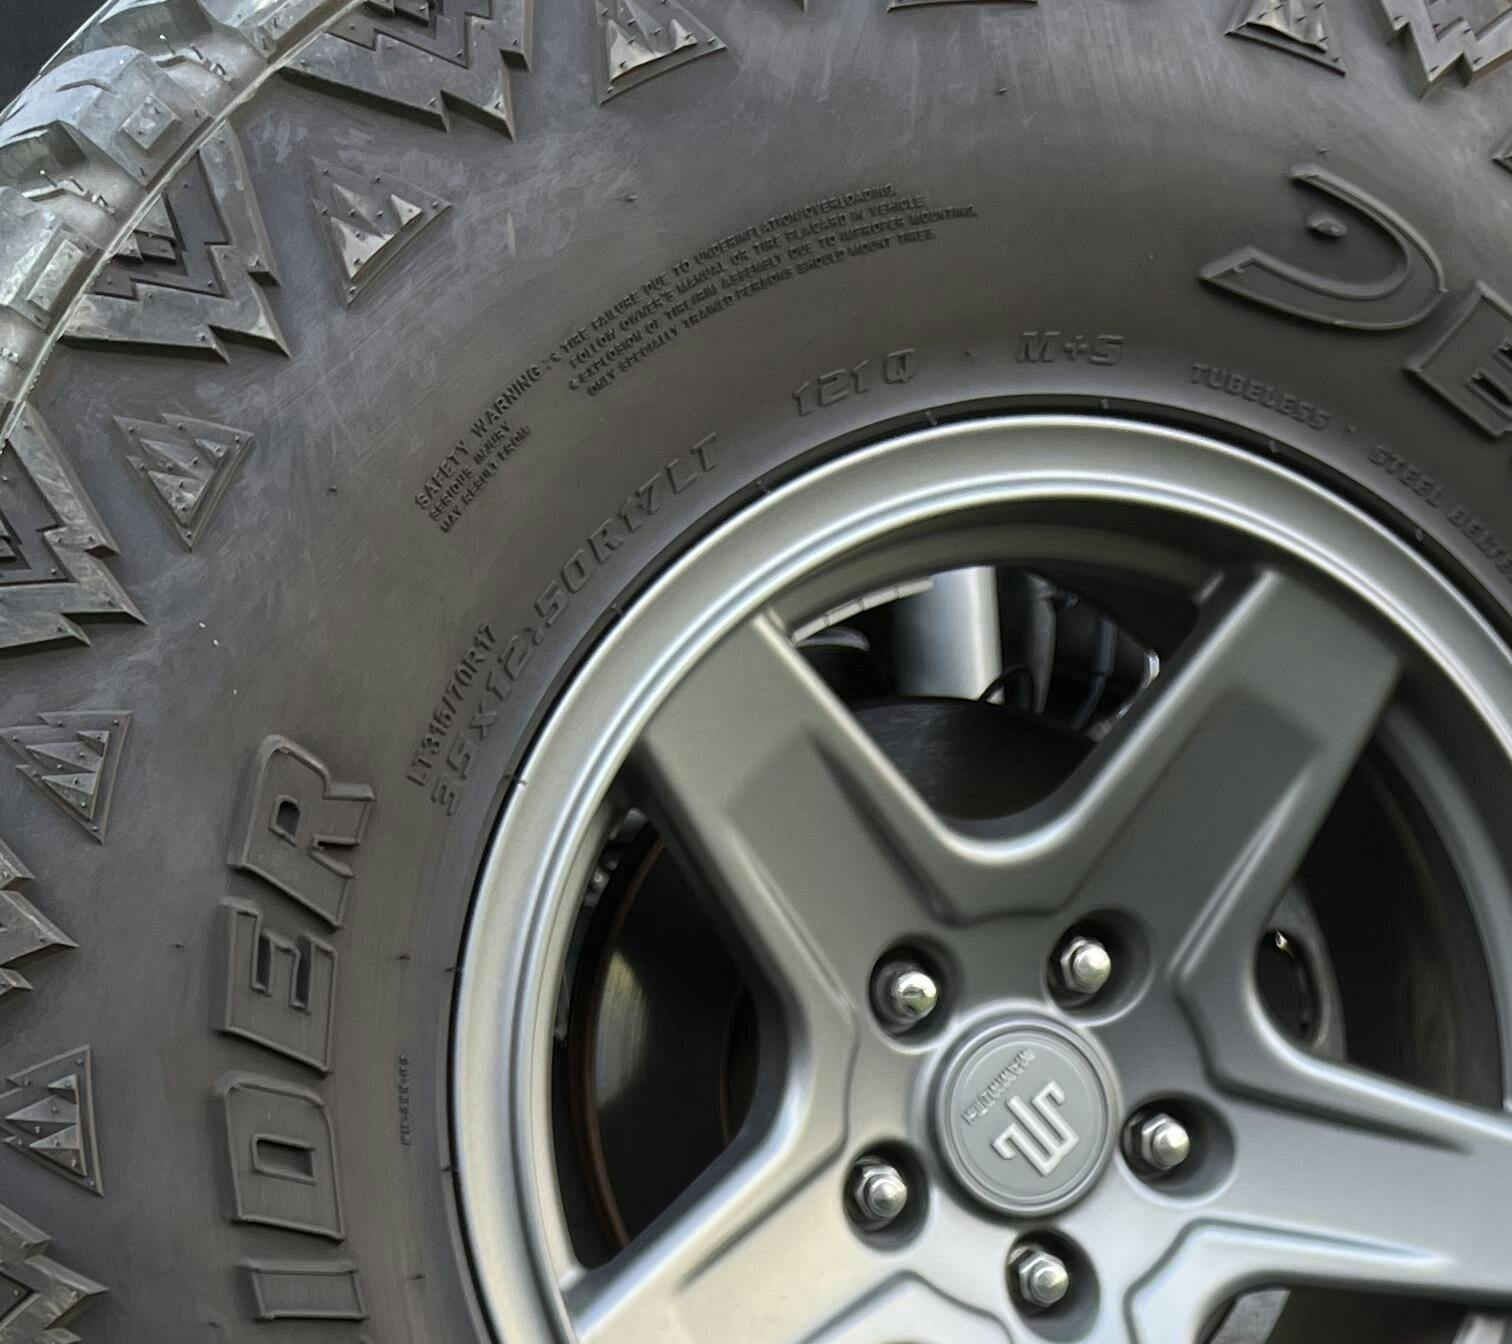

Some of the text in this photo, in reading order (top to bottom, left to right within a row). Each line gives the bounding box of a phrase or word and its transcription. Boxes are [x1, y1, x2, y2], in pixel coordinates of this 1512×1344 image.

[672, 259, 690, 276] TO
[1014, 330, 1124, 367] M+S
[1189, 364, 1331, 431] TUBELESS
[414, 364, 542, 510] SAFETY WARNING
[429, 421, 511, 521] SERIOUS INJURY
[440, 506, 462, 533] MAY
